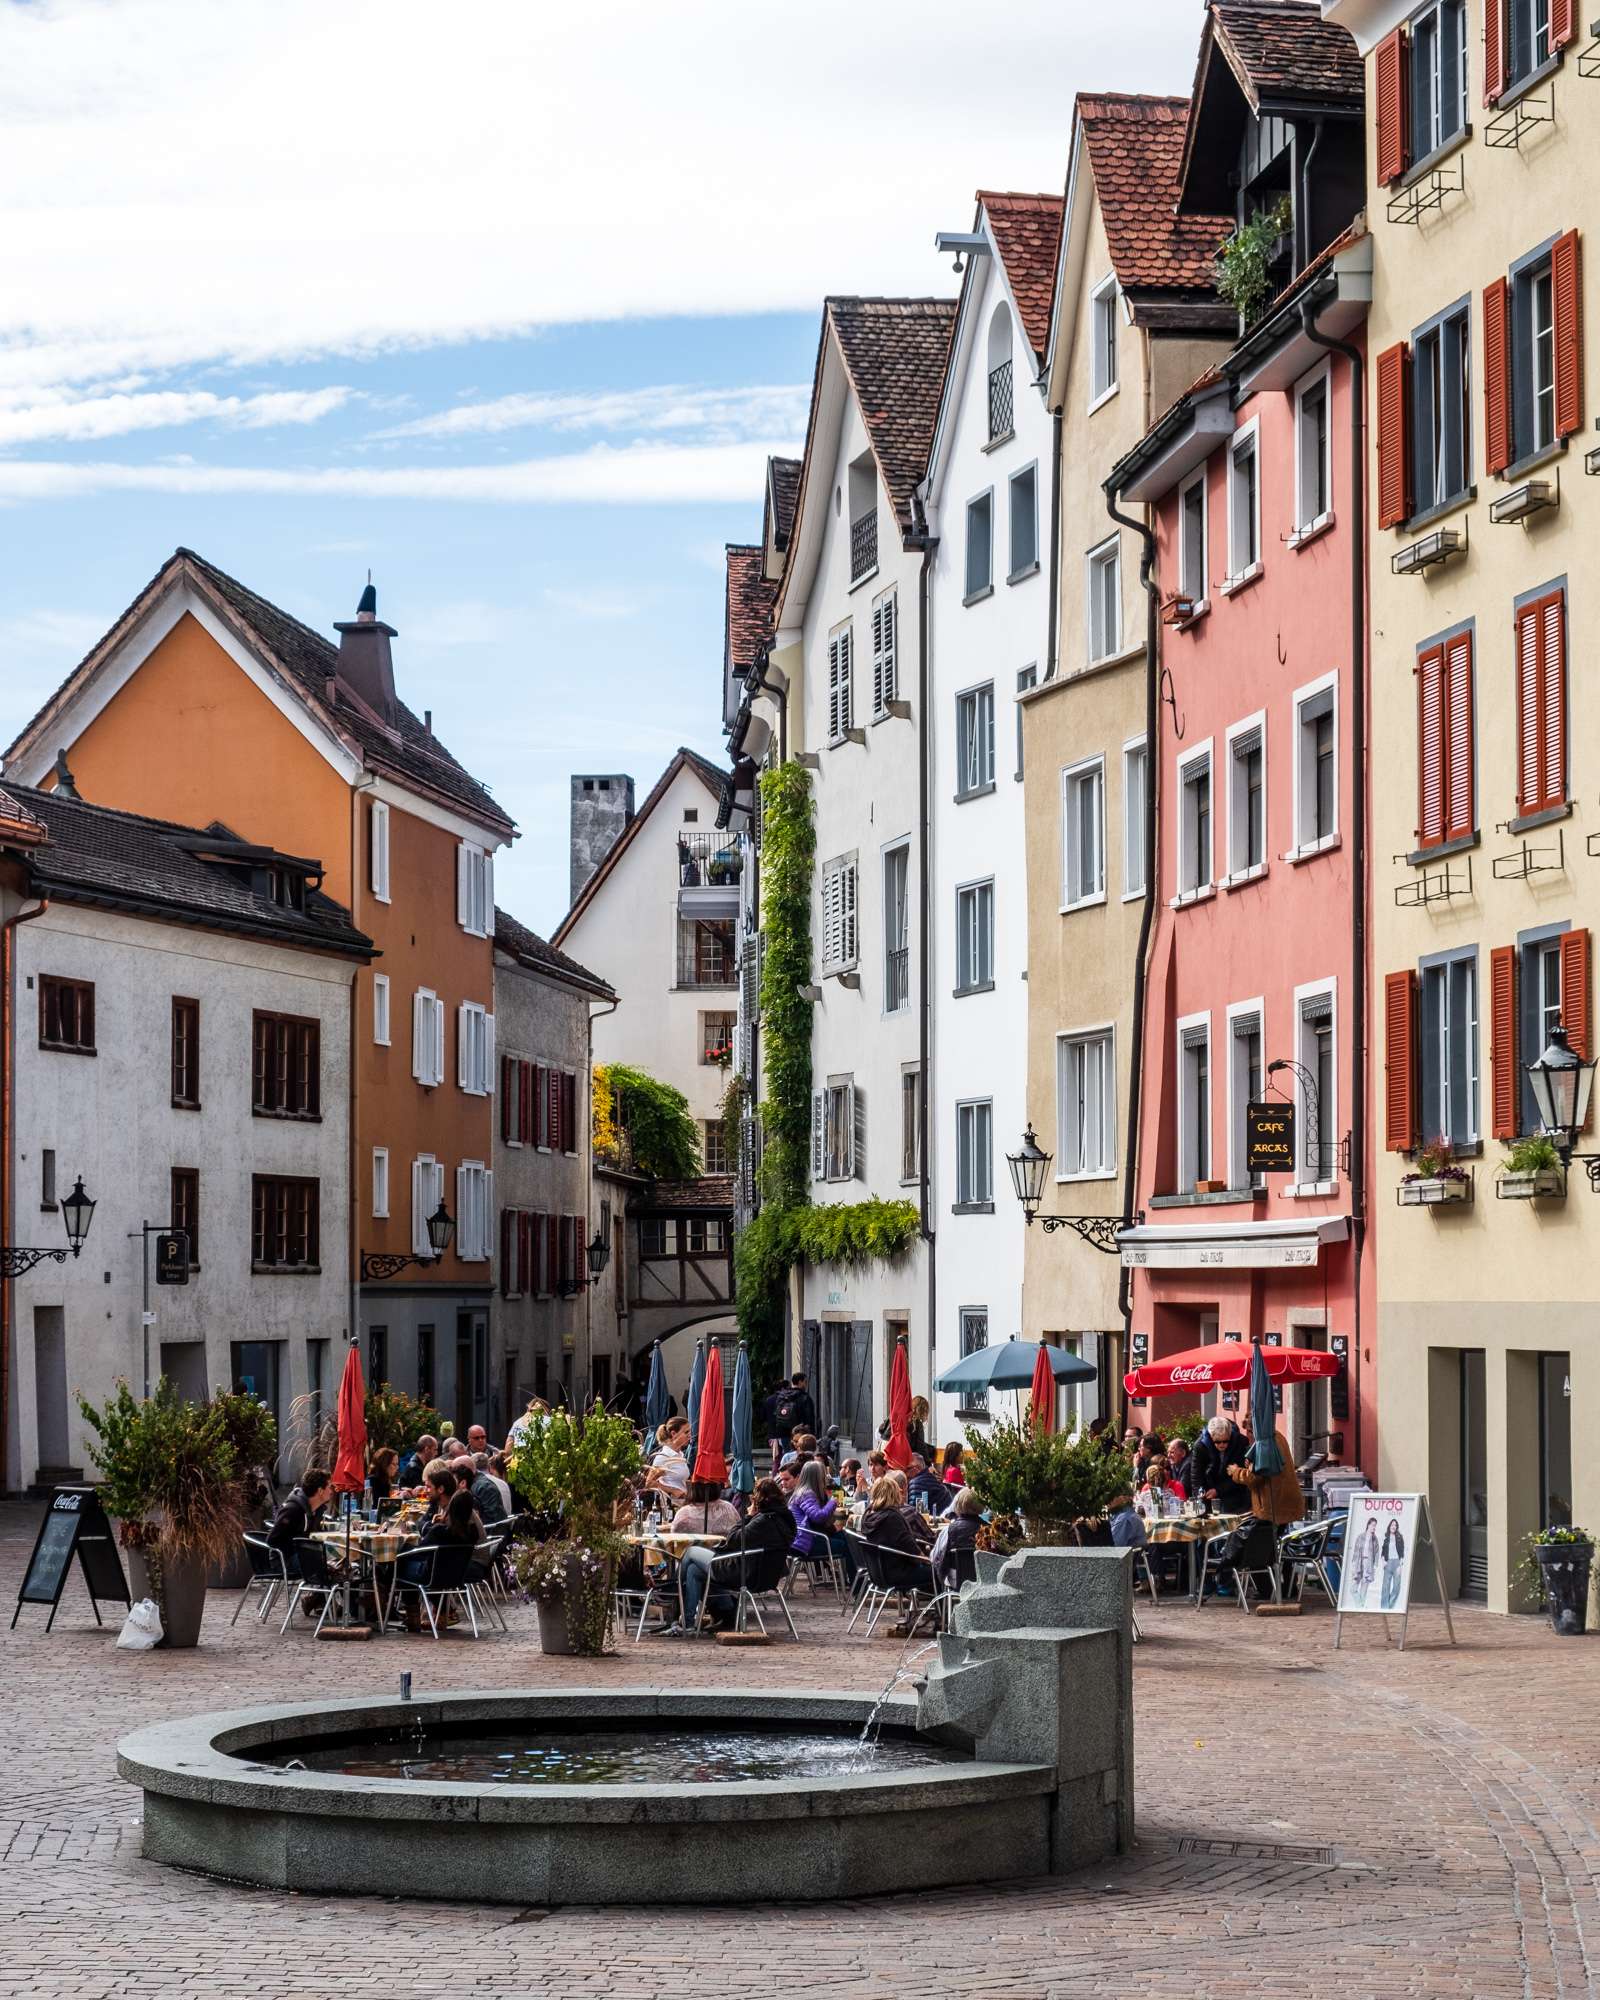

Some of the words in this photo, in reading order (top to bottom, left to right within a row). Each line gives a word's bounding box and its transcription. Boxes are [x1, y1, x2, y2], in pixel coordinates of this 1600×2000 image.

[1257, 1122, 1285, 1134] CAFE
[1254, 1144, 1289, 1153] ARCAS
[167, 1244, 178, 1260] P
[1170, 1363, 1215, 1383] Coca-Cola
[1364, 1498, 1403, 1511] burda
